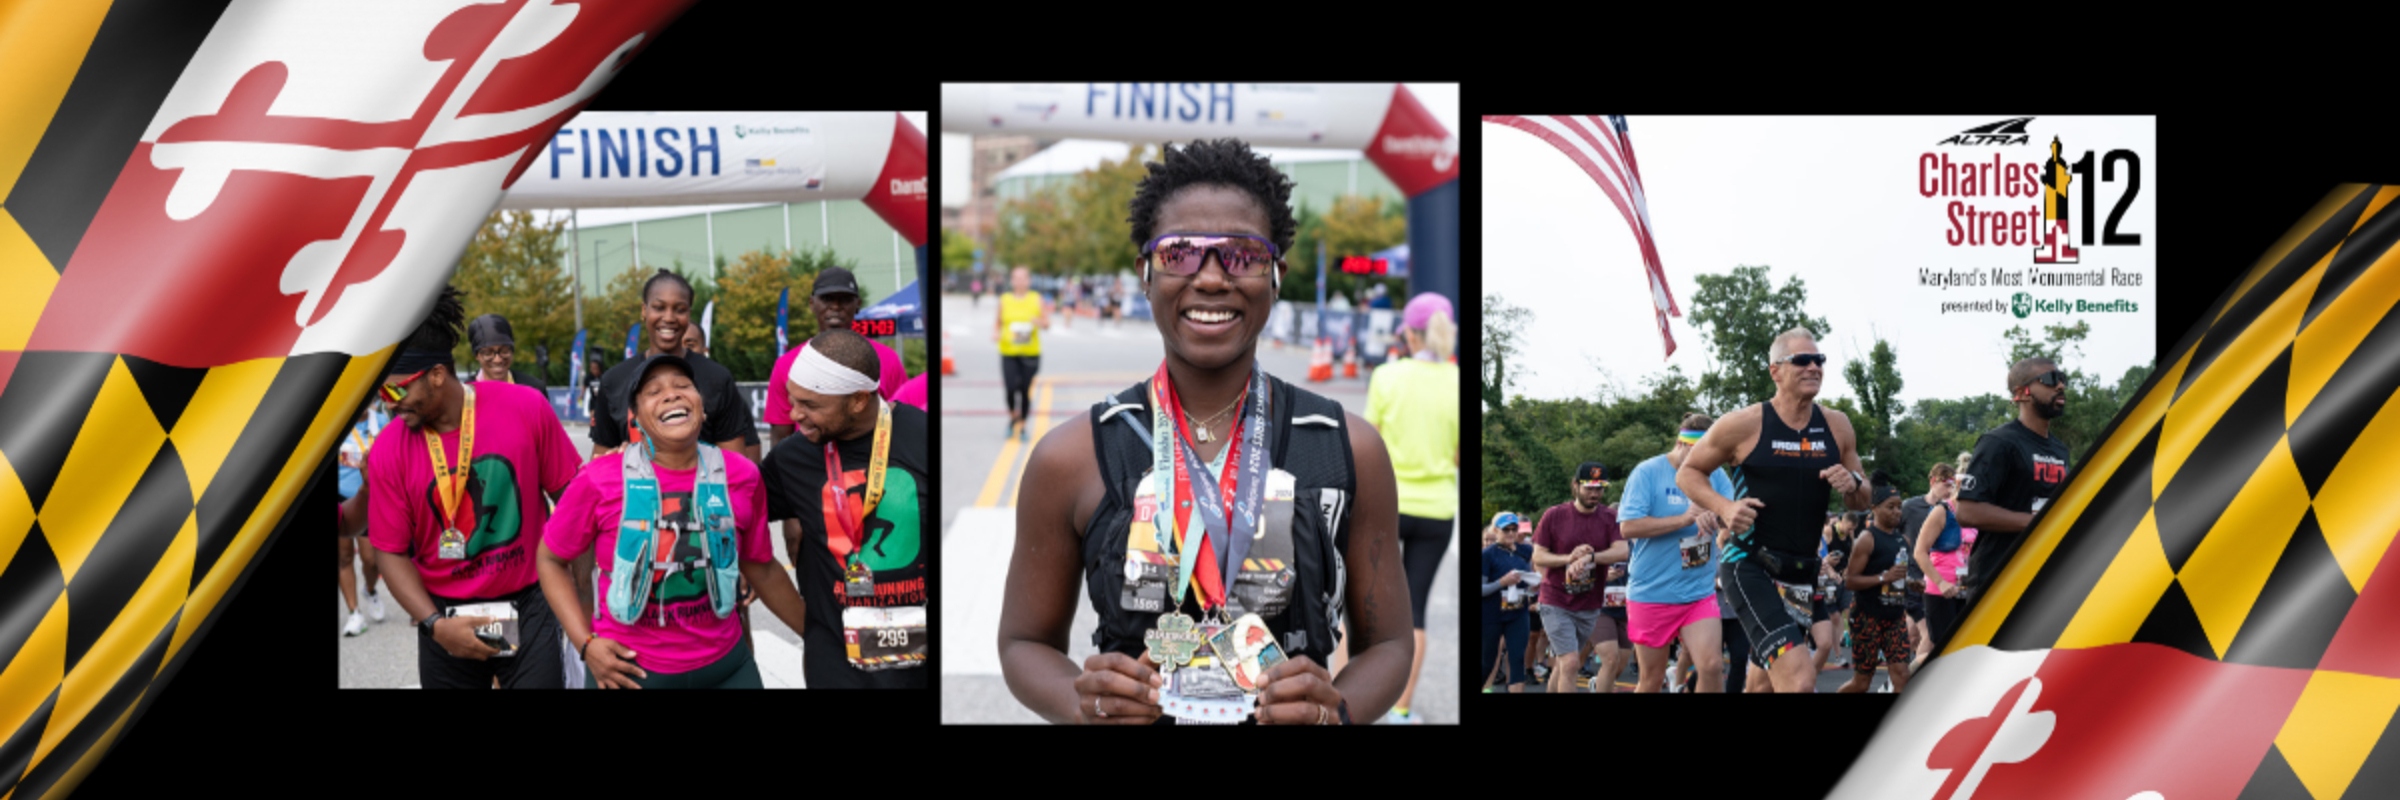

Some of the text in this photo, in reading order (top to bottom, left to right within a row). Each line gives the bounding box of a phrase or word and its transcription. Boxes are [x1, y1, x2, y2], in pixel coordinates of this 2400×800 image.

[550, 126, 720, 180] FINISH
[2033, 461, 2067, 484] run
[877, 628, 909, 648] 299
